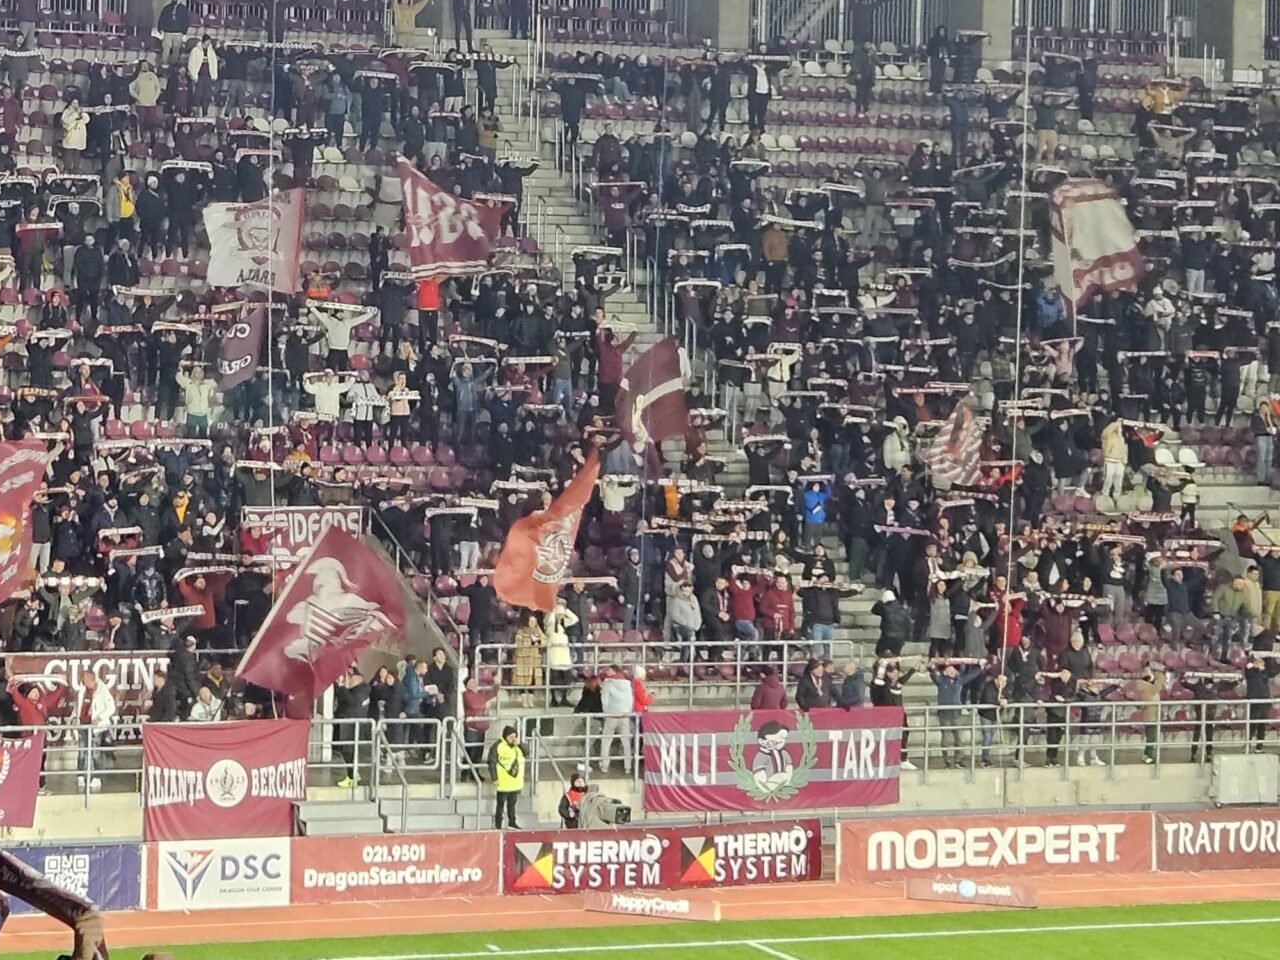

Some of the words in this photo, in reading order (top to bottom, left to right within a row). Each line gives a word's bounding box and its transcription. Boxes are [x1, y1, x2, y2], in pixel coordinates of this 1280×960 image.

[251, 757, 306, 799] BERCENI
[362, 844, 426, 863] 021.9501
[553, 835, 663, 865] THERMO
[713, 826, 808, 857] THERMO
[867, 823, 1127, 871] MOBEXPERT
[221, 853, 281, 881] DSC
[303, 864, 483, 892] DragonStarCurier.ro
[552, 862, 661, 889] SYSTEM
[714, 854, 807, 882] SYSTEM
[932, 881, 959, 895] spot
[977, 884, 1012, 897] wheel
[611, 894, 690, 914] HappyCredit
